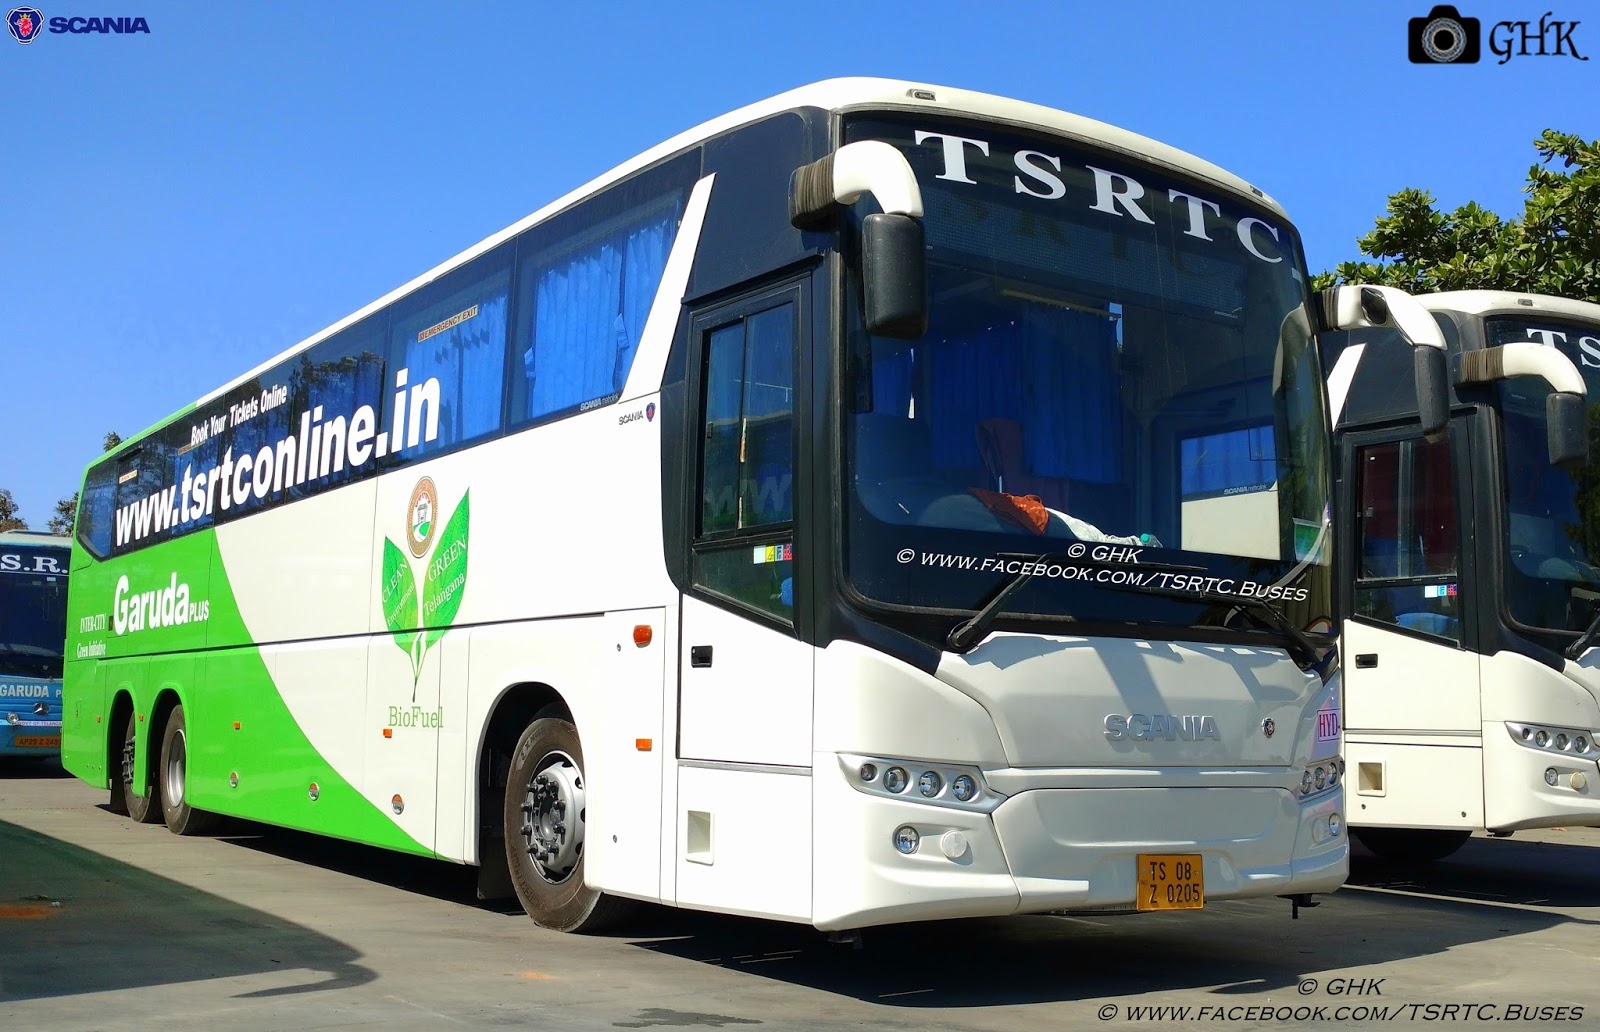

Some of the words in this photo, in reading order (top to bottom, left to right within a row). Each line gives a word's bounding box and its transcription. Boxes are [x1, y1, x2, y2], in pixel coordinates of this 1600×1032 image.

[914, 129, 1283, 264] TSRTC
[424, 314, 462, 338] EMERGENCY
[462, 306, 477, 320] EXIT
[190, 419, 209, 447] Book
[210, 414, 227, 437] Your
[229, 396, 258, 428] Tickets
[260, 384, 287, 413] Online
[580, 398, 601, 411] SCANIA
[618, 410, 644, 425] SCANIA
[116, 368, 441, 547] www.tsrtconline.in
[1223, 486, 1248, 495] SCANIA
[427, 534, 467, 583] GREEN
[382, 557, 408, 604] CLEAN
[423, 572, 465, 617] Telangana
[113, 572, 190, 636] Garuda
[188, 600, 210, 622] PLUS
[80, 613, 106, 633] INTER-CITY
[0, 684, 49, 698] GARUDA
[388, 705, 444, 729] BioFuel
[1104, 713, 1221, 742] SCANIA
[1149, 862, 1166, 881] TS
[1175, 862, 1192, 881] 08
[1149, 884, 1158, 904] Z
[1167, 883, 1200, 903] 0205
